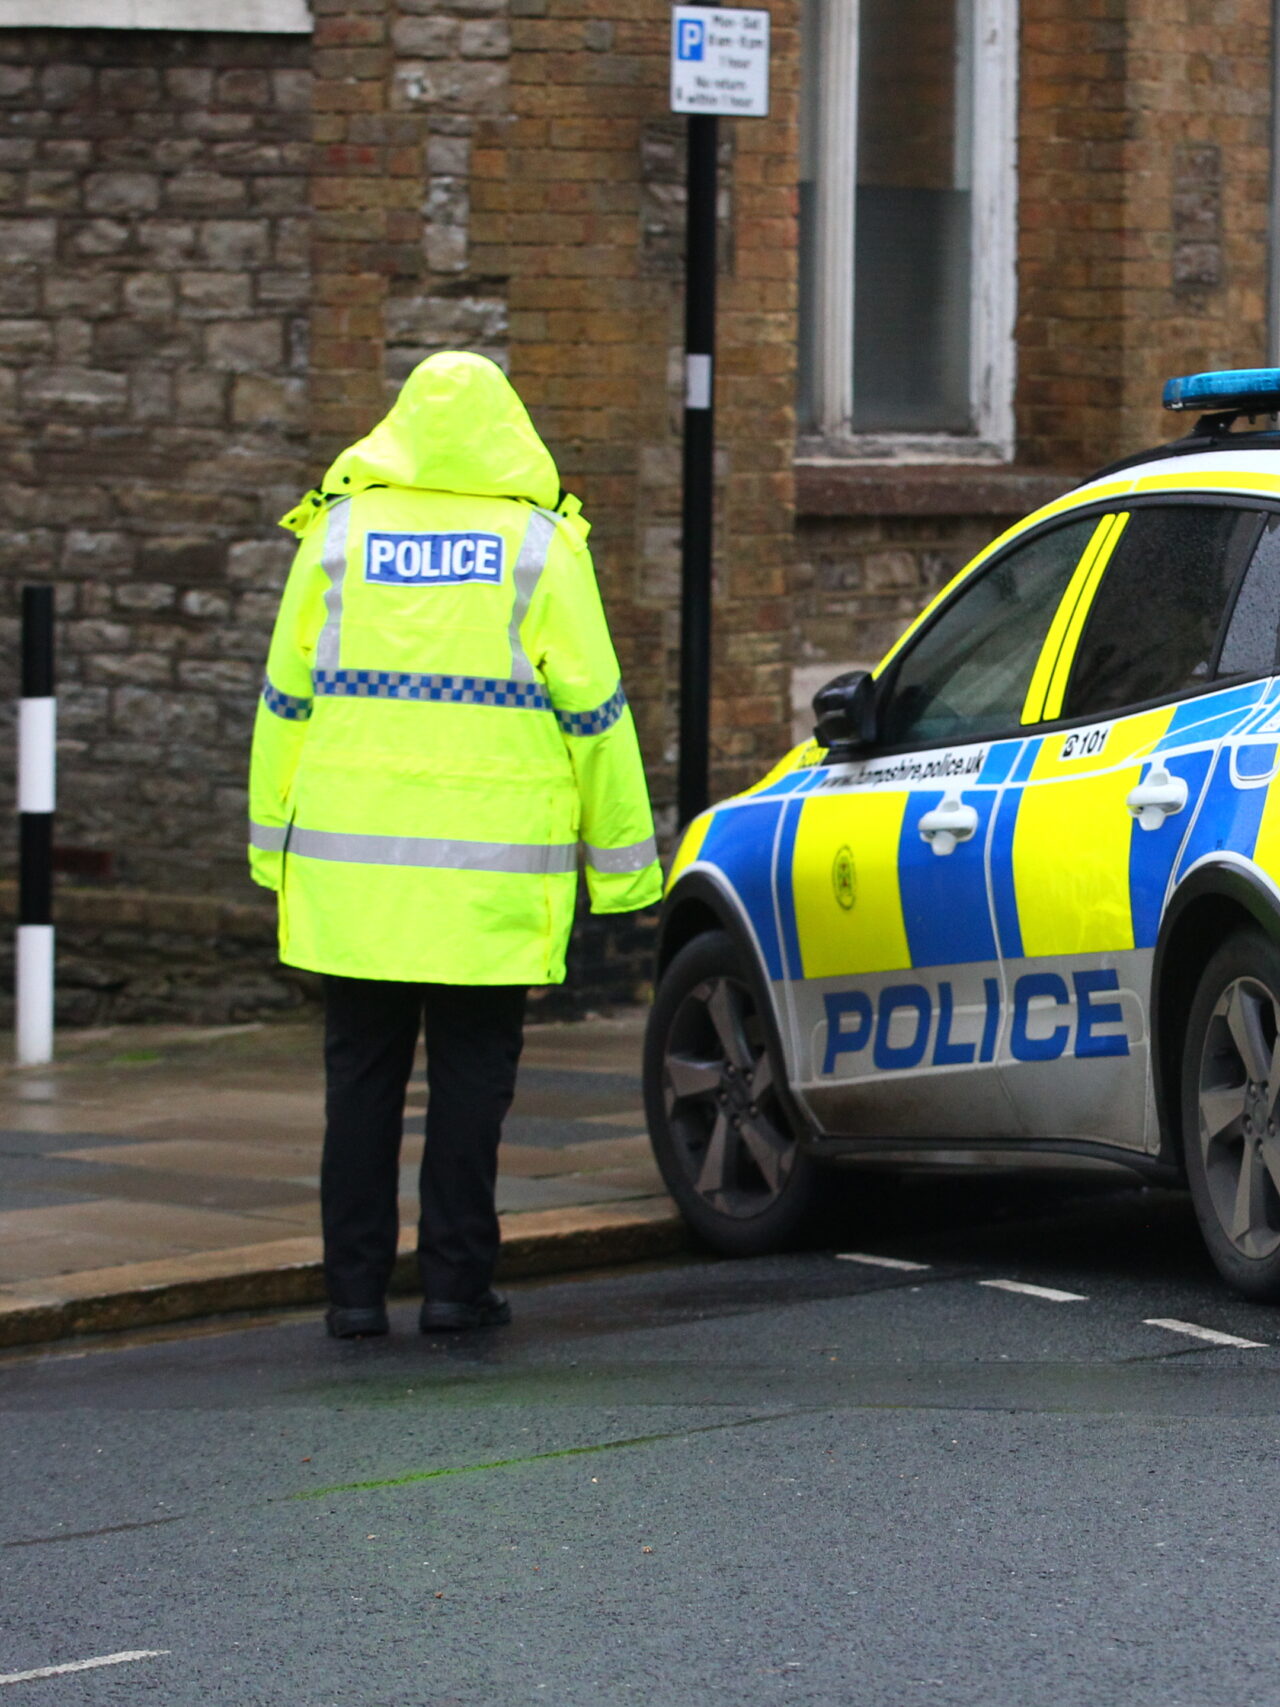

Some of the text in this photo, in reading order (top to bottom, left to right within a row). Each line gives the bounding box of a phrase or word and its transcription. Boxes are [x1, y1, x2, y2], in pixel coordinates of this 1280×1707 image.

[683, 23, 701, 58] P
[370, 539, 498, 577] POLICE
[1080, 728, 1109, 754] 101
[821, 968, 1130, 1075] POLICE
